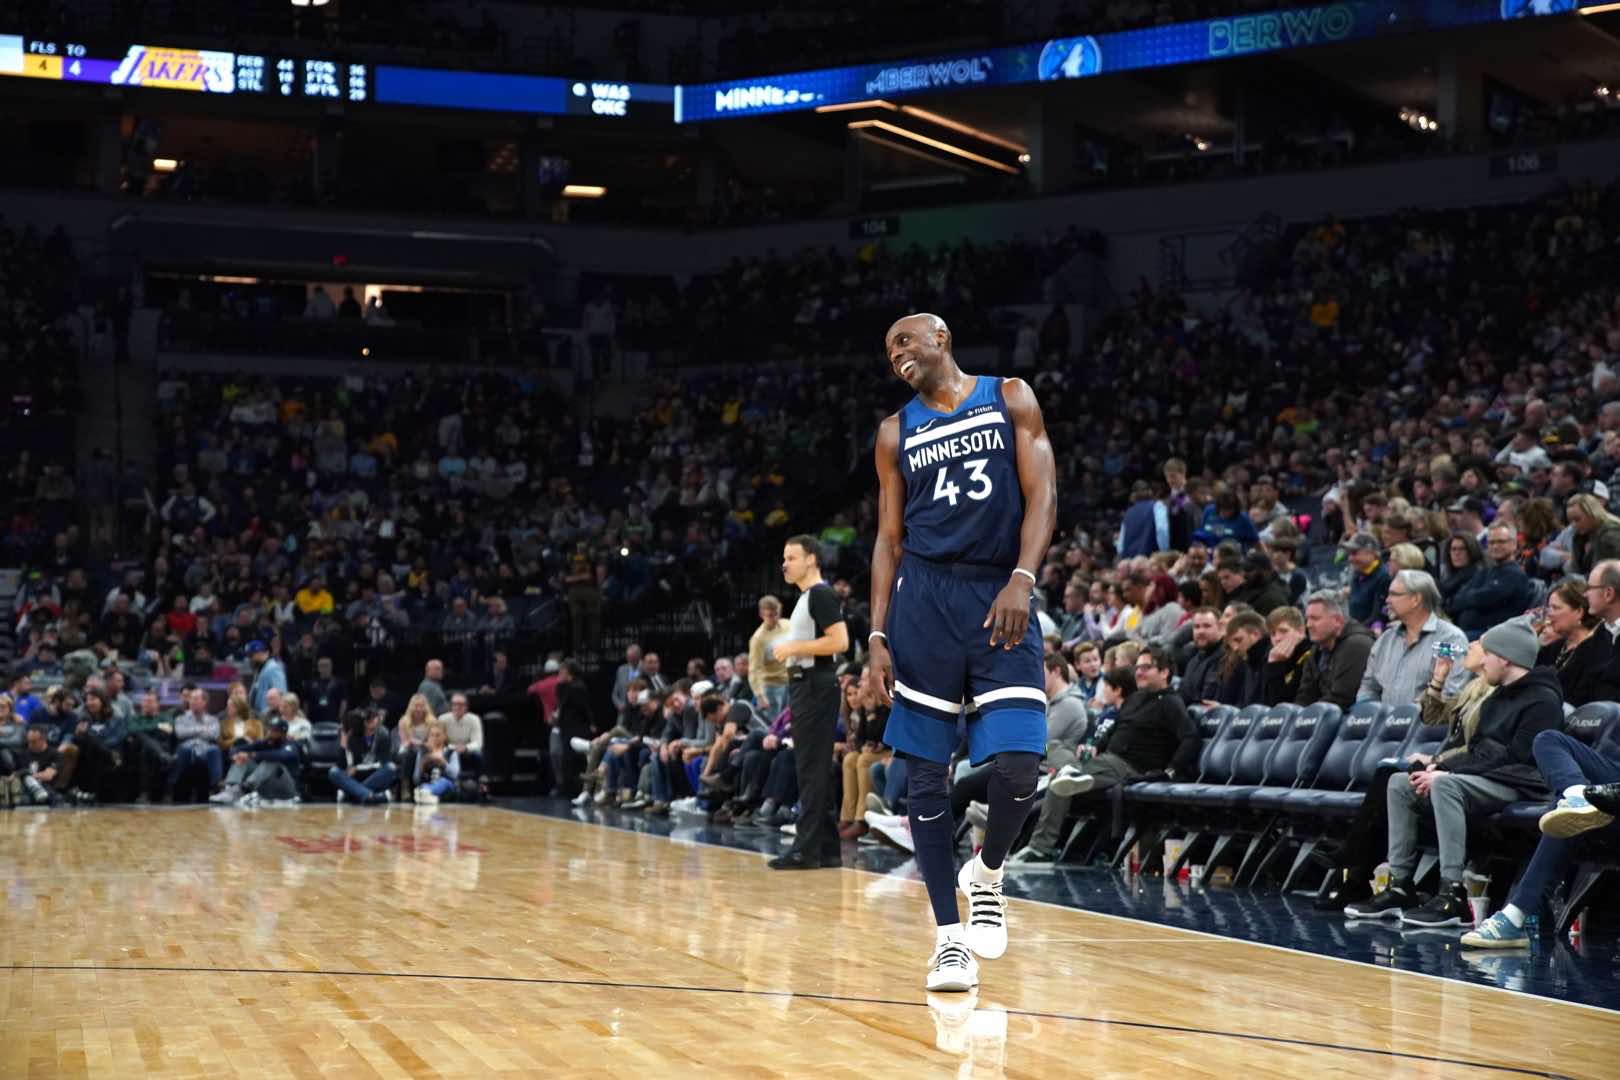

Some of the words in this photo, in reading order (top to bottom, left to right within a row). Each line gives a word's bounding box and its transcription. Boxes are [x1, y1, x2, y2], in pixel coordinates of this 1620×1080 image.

[31, 42, 56, 55] FLS
[66, 44, 87, 57] TO
[69, 60, 81, 76] 4
[592, 83, 630, 100] WAS
[592, 99, 626, 115] OKC
[974, 405, 993, 414] fitbit
[908, 429, 1004, 473] MINNESOTA
[933, 459, 992, 505] 43
